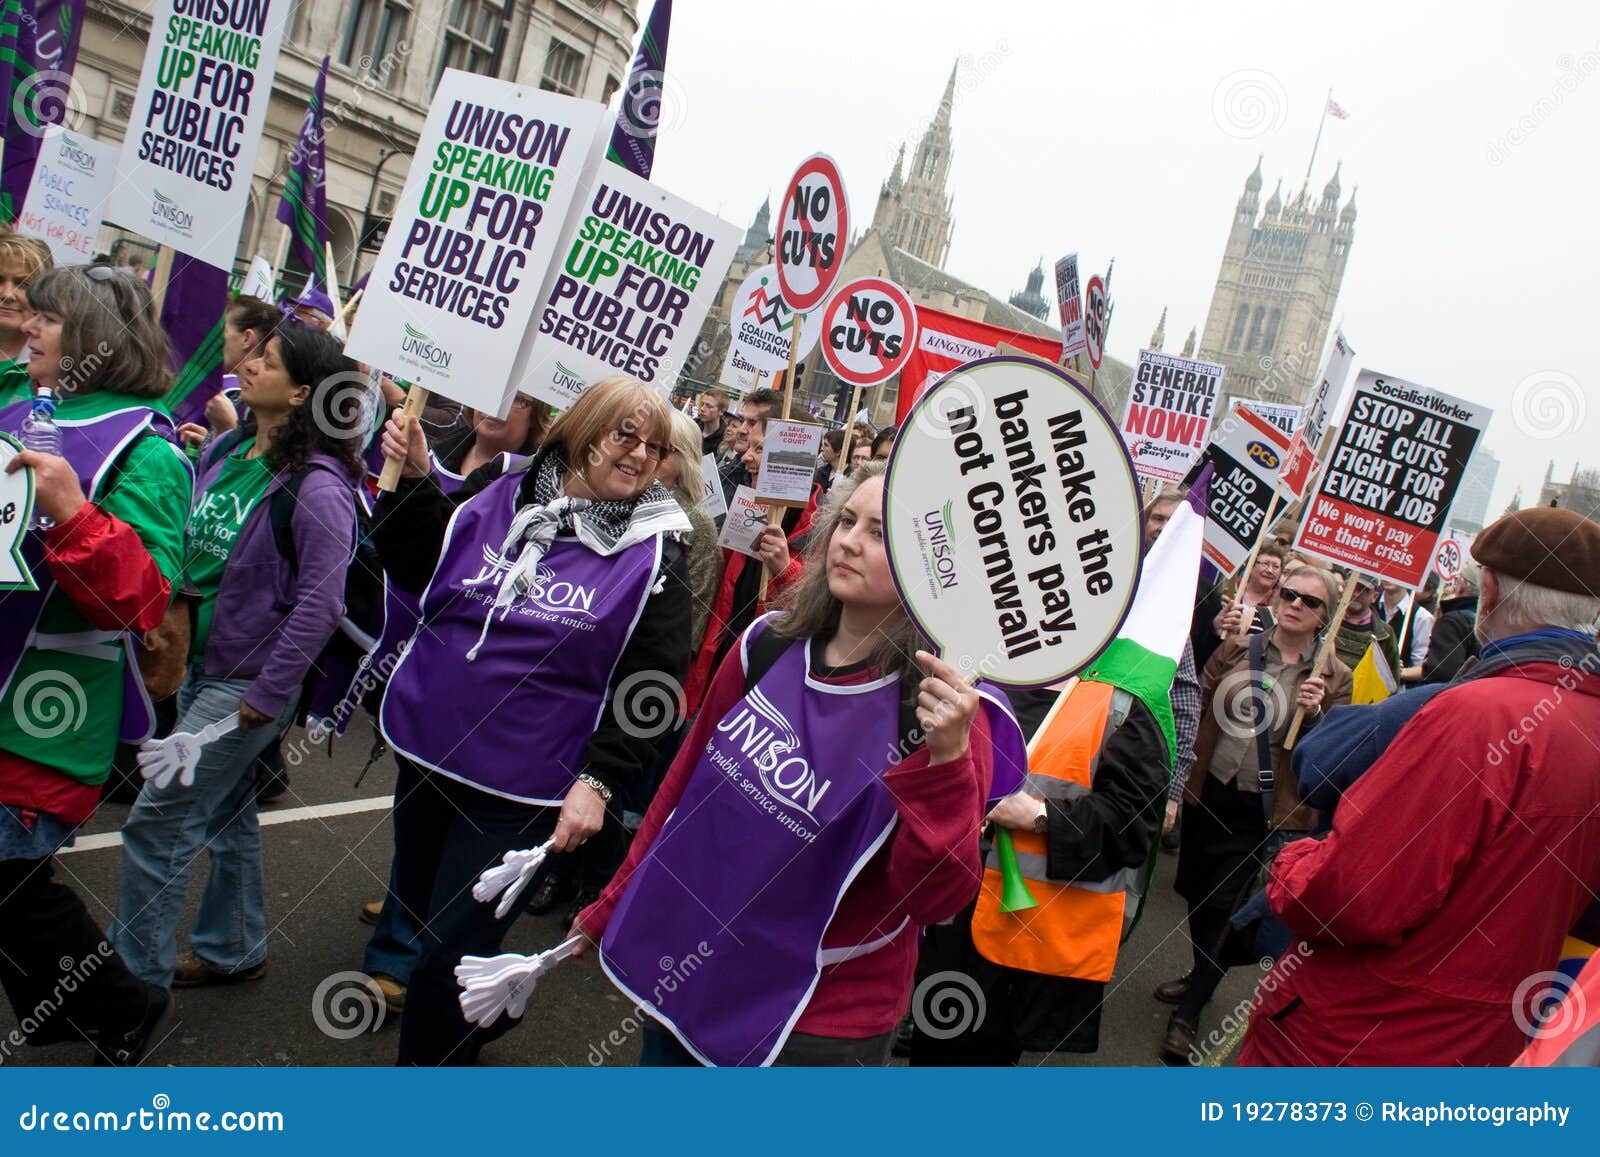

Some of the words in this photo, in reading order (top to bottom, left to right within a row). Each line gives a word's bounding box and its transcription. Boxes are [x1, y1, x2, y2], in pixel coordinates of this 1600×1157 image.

[165, 14, 261, 70] SPEAKING
[157, 46, 196, 92] UP
[193, 58, 255, 116] FOR
[145, 89, 244, 159] PUBLIC
[444, 100, 571, 168] UNISON
[138, 131, 235, 192] SERVICES
[432, 141, 555, 201] SPEAKING
[23, 211, 46, 231] NOT
[152, 200, 193, 228] UNISON
[418, 173, 471, 223] UP
[465, 186, 544, 250] FOR
[791, 185, 831, 222] NO
[591, 183, 715, 268] UNISON
[401, 218, 526, 294] PUBLIC
[579, 215, 701, 292] SPEAKING
[780, 229, 836, 270] CUTS
[388, 261, 511, 330] SERVICES
[564, 238, 620, 286] UP
[613, 263, 691, 327] FOR
[547, 273, 674, 358] PUBLIC
[846, 295, 895, 326] NO
[1090, 288, 1104, 321] NO
[402, 335, 452, 367] UNISON
[538, 308, 660, 383] SERVICES
[741, 321, 792, 350] COALITION
[829, 324, 903, 359] CUTS
[926, 335, 986, 359] KINGSTON
[1137, 362, 1217, 399] GENERAL
[1141, 352, 1151, 361] 24
[1150, 354, 1170, 366] HOUR
[1169, 357, 1195, 371] PUBLIC
[1194, 362, 1221, 376] SECTOR
[1132, 383, 1213, 418] STRIKE
[779, 431, 812, 441] SAMPSON
[783, 437, 807, 445] COURT
[787, 426, 806, 434] SAVE
[946, 404, 996, 477] not
[1125, 404, 1208, 449] NOW!
[1354, 396, 1415, 431] STOP
[1414, 416, 1453, 449] ALL
[1139, 447, 1171, 460] Party
[1144, 441, 1189, 458] Socialist
[1248, 444, 1278, 467] pcs
[1343, 420, 1389, 454] THE
[1391, 437, 1450, 476] CUTS,
[1228, 467, 1257, 494] NO
[1333, 446, 1402, 485] FIGHT
[1401, 469, 1446, 502] FOR
[992, 388, 1056, 557] bankers
[1027, 562, 1078, 648] pay,
[1047, 409, 1096, 524] Make
[1075, 528, 1114, 597] the
[1208, 472, 1266, 526] USTICE
[1210, 497, 1255, 539] CUTS
[1324, 470, 1395, 512] EVERY
[1394, 495, 1437, 526] JOB
[213, 522, 237, 542] for
[912, 516, 920, 528] the
[914, 529, 927, 551] public
[1308, 517, 1333, 538] for
[1334, 527, 1373, 552] their
[1374, 543, 1414, 567] crisis
[1316, 499, 1340, 521] We
[1343, 512, 1385, 537] won't
[1384, 527, 1414, 548] pay
[921, 552, 933, 578] service
[925, 510, 958, 589] UNISON
[1445, 544, 1458, 561] NO
[927, 578, 939, 600] union
[966, 481, 1043, 661] Cornwall
[464, 587, 484, 601] the
[520, 606, 559, 622] service
[561, 615, 597, 632] union
[709, 749, 743, 782] public
[740, 777, 778, 815] service
[776, 810, 817, 844] union
